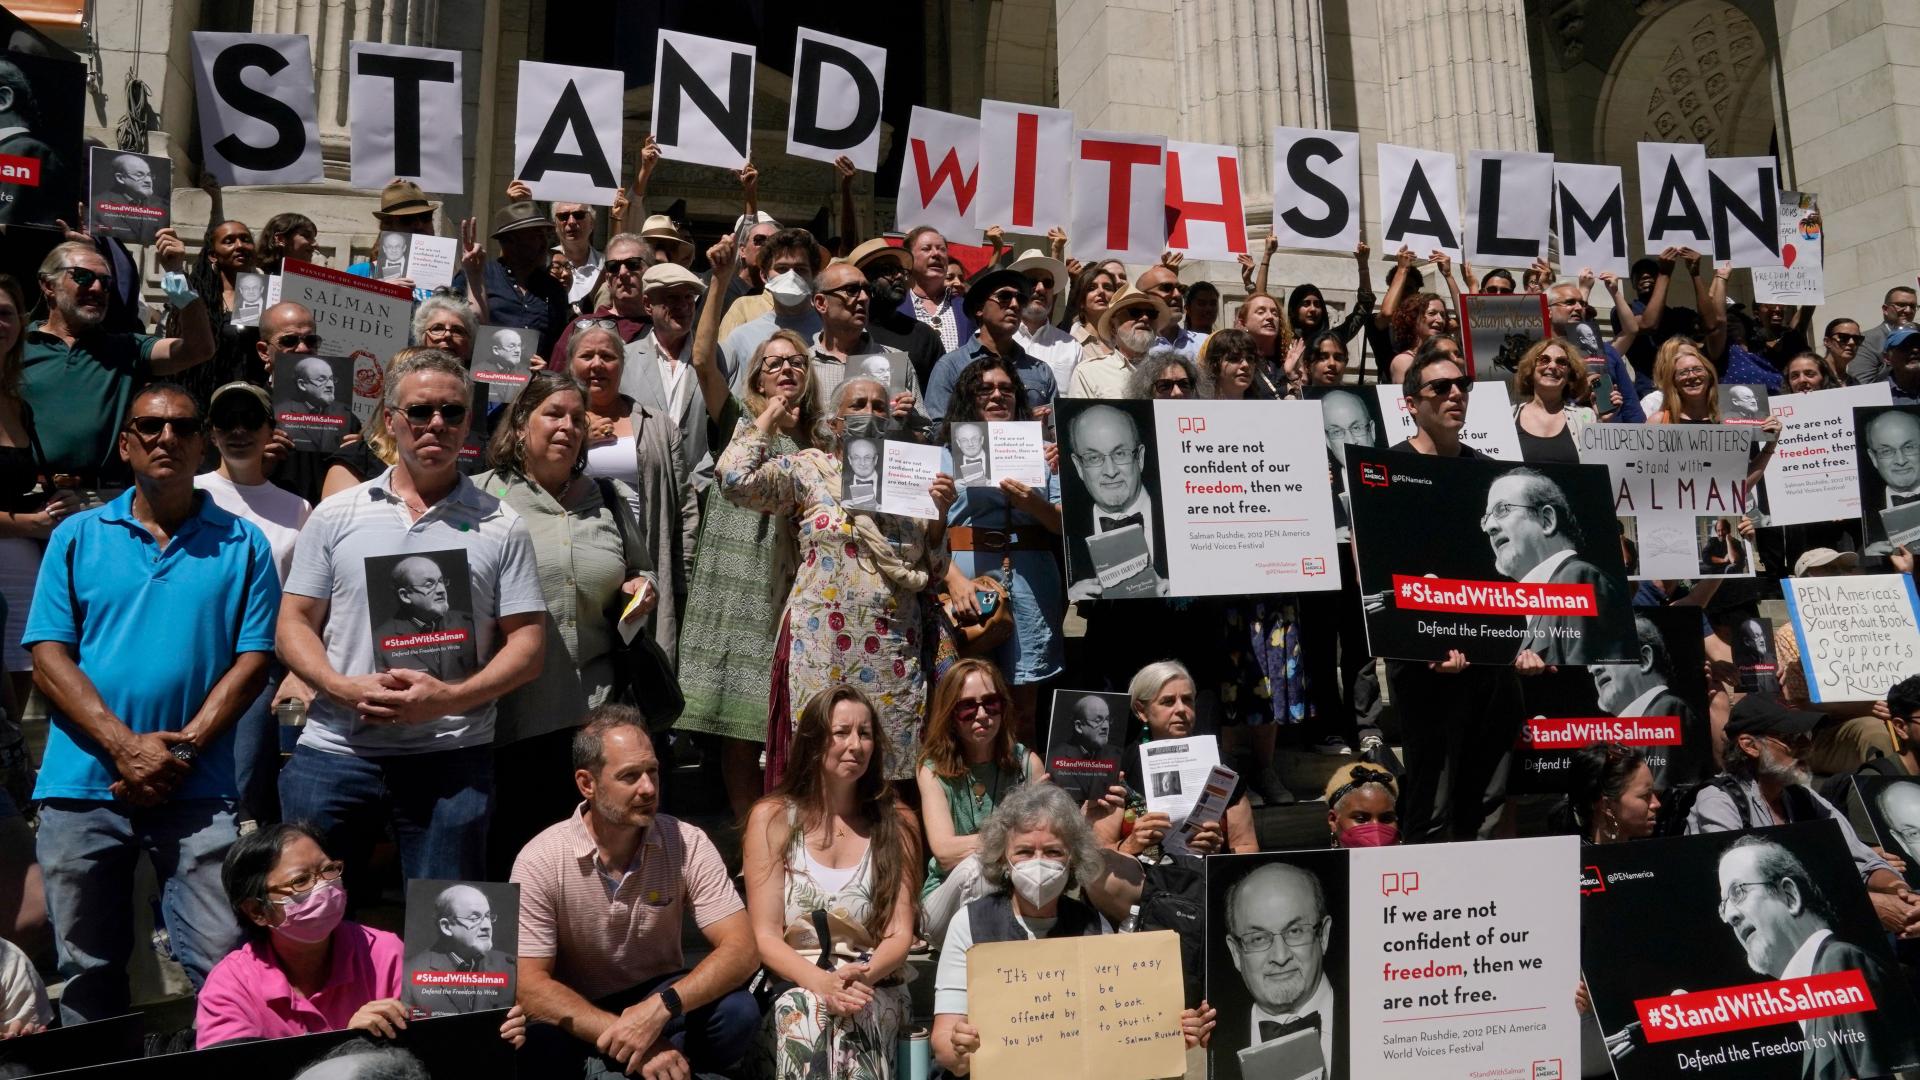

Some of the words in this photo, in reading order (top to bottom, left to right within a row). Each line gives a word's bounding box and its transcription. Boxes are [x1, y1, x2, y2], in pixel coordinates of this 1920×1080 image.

[100, 203, 163, 216] #StandWithSalman
[1779, 208, 1798, 217] OOKS
[1755, 271, 1790, 281] FREEDOM
[1768, 280, 1816, 291] SPEECH!!!
[304, 287, 390, 318] SALMAN
[282, 414, 343, 424] #StandWithSalman
[1402, 416, 1410, 426] If
[1824, 417, 1842, 426] not
[1458, 430, 1468, 439] of
[1584, 428, 1654, 451] CHILDREN'S
[1658, 430, 1684, 452] BOOK
[1688, 430, 1749, 453] WRITERS
[1778, 432, 1829, 446] confident
[1832, 430, 1842, 439] of
[1182, 441, 1192, 453] If
[1195, 443, 1213, 453] we
[1218, 443, 1238, 453] are
[1243, 441, 1264, 452] not
[1780, 448, 1829, 459] freedom,
[1184, 460, 1247, 473] confident
[1251, 460, 1264, 472] of
[1269, 463, 1290, 472] our
[1782, 464, 1799, 472] are
[1802, 460, 1820, 470] not
[1822, 458, 1849, 467] free.
[1185, 481, 1247, 494] freedom,
[1251, 480, 1281, 492] then
[1285, 483, 1302, 492] we
[1392, 474, 1432, 485] @PENamerica
[1616, 477, 1747, 514] ALMAN
[1188, 504, 1208, 514] are
[1213, 502, 1235, 514] not
[1239, 501, 1271, 513] free.
[1190, 532, 1215, 540] Salman
[1216, 531, 1245, 539] Rushdie,
[1238, 541, 1264, 549] Festival
[1401, 583, 1589, 609] #StandWithSalman
[1799, 586, 1831, 602] PEN
[1802, 603, 1868, 619] Children's
[1873, 602, 1898, 613] and
[1418, 621, 1456, 637] Defend
[1460, 624, 1477, 637] the
[1480, 625, 1531, 638] Freedom
[1533, 628, 1545, 638] to
[1549, 627, 1581, 639] Write
[1805, 618, 1849, 632] Young
[1851, 617, 1878, 628] Adult
[1880, 615, 1913, 628] Book
[385, 633, 464, 647] #StandWithSalman
[1834, 630, 1891, 643] Commitee
[1817, 638, 1913, 662] Supports
[1846, 674, 1906, 695] RUSHD
[1522, 722, 1675, 742] StandWithSalman
[1056, 760, 1113, 769] #StandWithSalman
[1525, 758, 1559, 773] Defend
[1563, 758, 1571, 769] th
[1608, 870, 1654, 883] @PENamerica
[1384, 906, 1397, 924] If
[1402, 910, 1427, 922] we
[1433, 908, 1461, 921] are
[1467, 901, 1497, 918] not
[1383, 931, 1470, 952] confident
[1476, 927, 1495, 946] of
[1500, 930, 1529, 944] our
[1037, 968, 1066, 982] very
[1094, 963, 1120, 977] very
[1132, 959, 1162, 971] easy
[1383, 960, 1468, 981] freedom,
[1473, 956, 1513, 974] then
[1519, 958, 1543, 970] we
[416, 974, 504, 984] #StandWithSalman
[1034, 992, 1052, 1003] not
[1066, 989, 1076, 998] to
[1100, 984, 1114, 993] be
[1383, 997, 1413, 1010] are
[1418, 989, 1449, 1007] not
[1454, 986, 1497, 1004] free.
[1011, 1012, 1055, 1024] offended
[1065, 1010, 1076, 1020] by
[1115, 998, 1145, 1008] book.
[1648, 983, 1864, 1030] #StandWithSalman
[1028, 1034, 1043, 1046] just
[1060, 1029, 1080, 1040] have
[1100, 1022, 1111, 1031] to
[1119, 1018, 1139, 1028] shut
[1125, 1036, 1152, 1045] Salman
[1155, 1030, 1182, 1040] Rushdie
[1383, 1033, 1418, 1045] Salman
[1420, 1030, 1460, 1042] Rushdie,
[1463, 1029, 1483, 1039] 2012
[1486, 1025, 1506, 1035] PEN
[1509, 1023, 1547, 1033] America
[1384, 1049, 1412, 1060] World
[1416, 1046, 1446, 1056] Voices
[1449, 1042, 1484, 1054] Festival
[1678, 1047, 1730, 1071] Defend
[1730, 1044, 1750, 1062] the
[1752, 1036, 1810, 1058] Freedom
[1812, 1035, 1827, 1049] to
[1828, 1028, 1866, 1046] Write
[1469, 1067, 1525, 1078] #StandWithSalman
